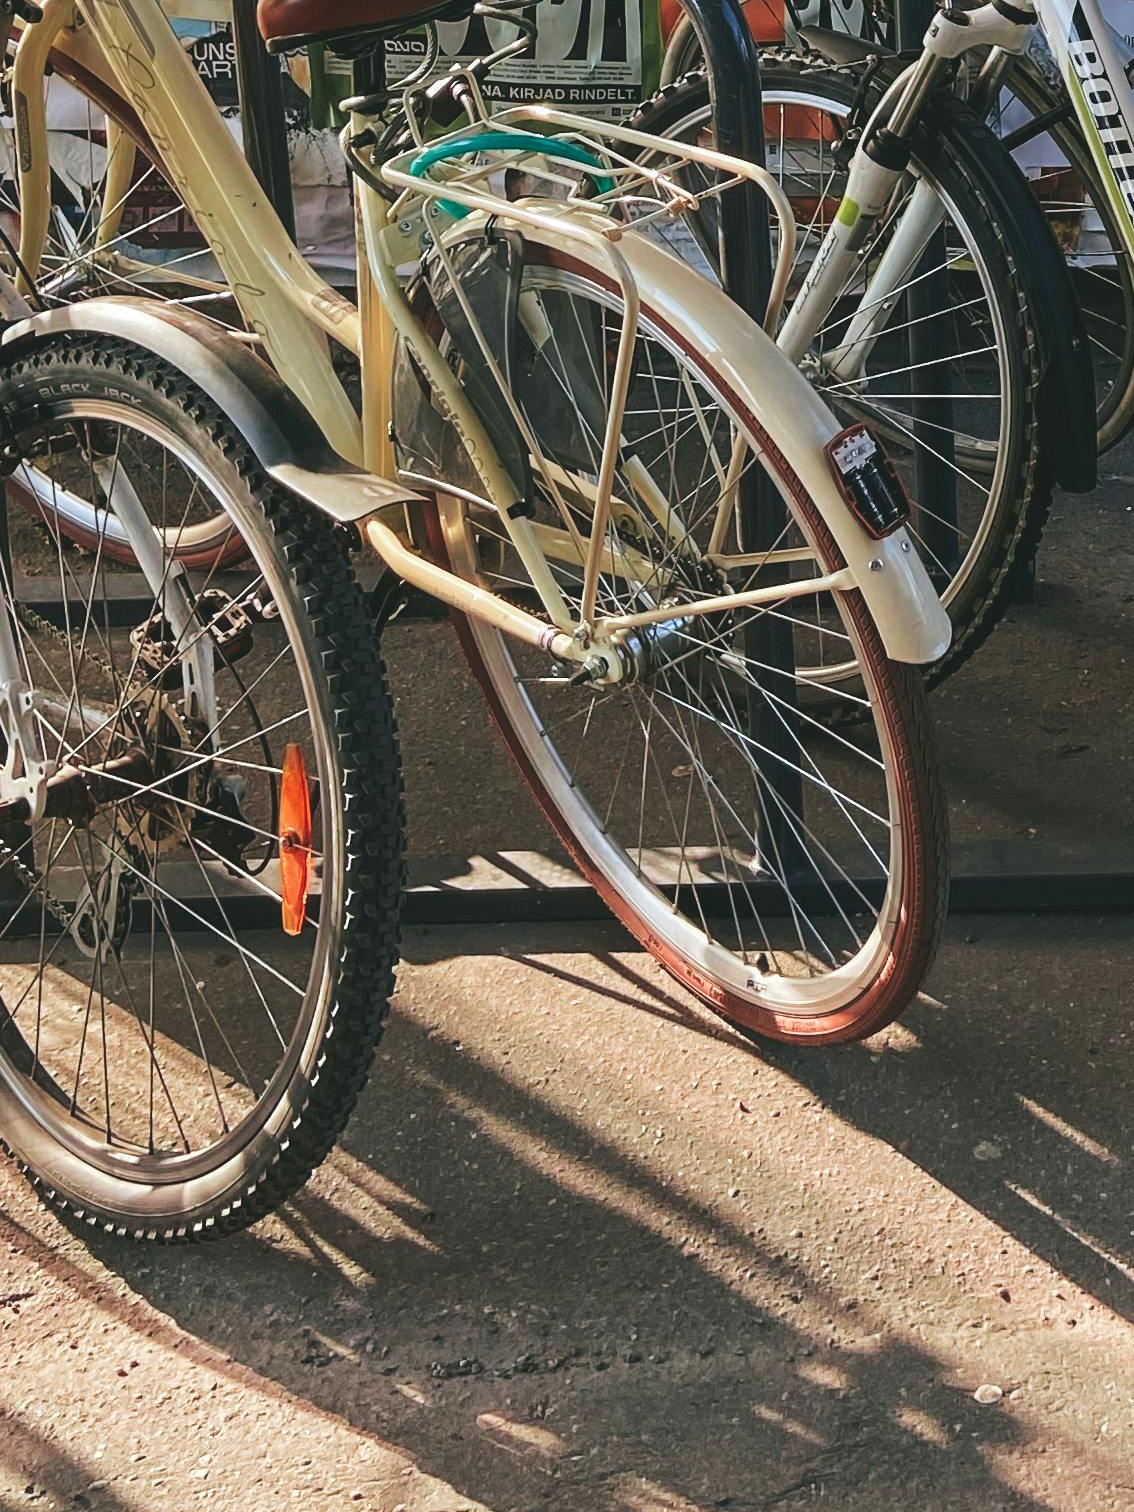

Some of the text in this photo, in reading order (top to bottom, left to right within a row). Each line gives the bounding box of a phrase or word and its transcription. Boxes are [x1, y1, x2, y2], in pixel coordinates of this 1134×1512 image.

[508, 86, 567, 101] KIRJAD
[38, 383, 143, 407] BLACK JACK
